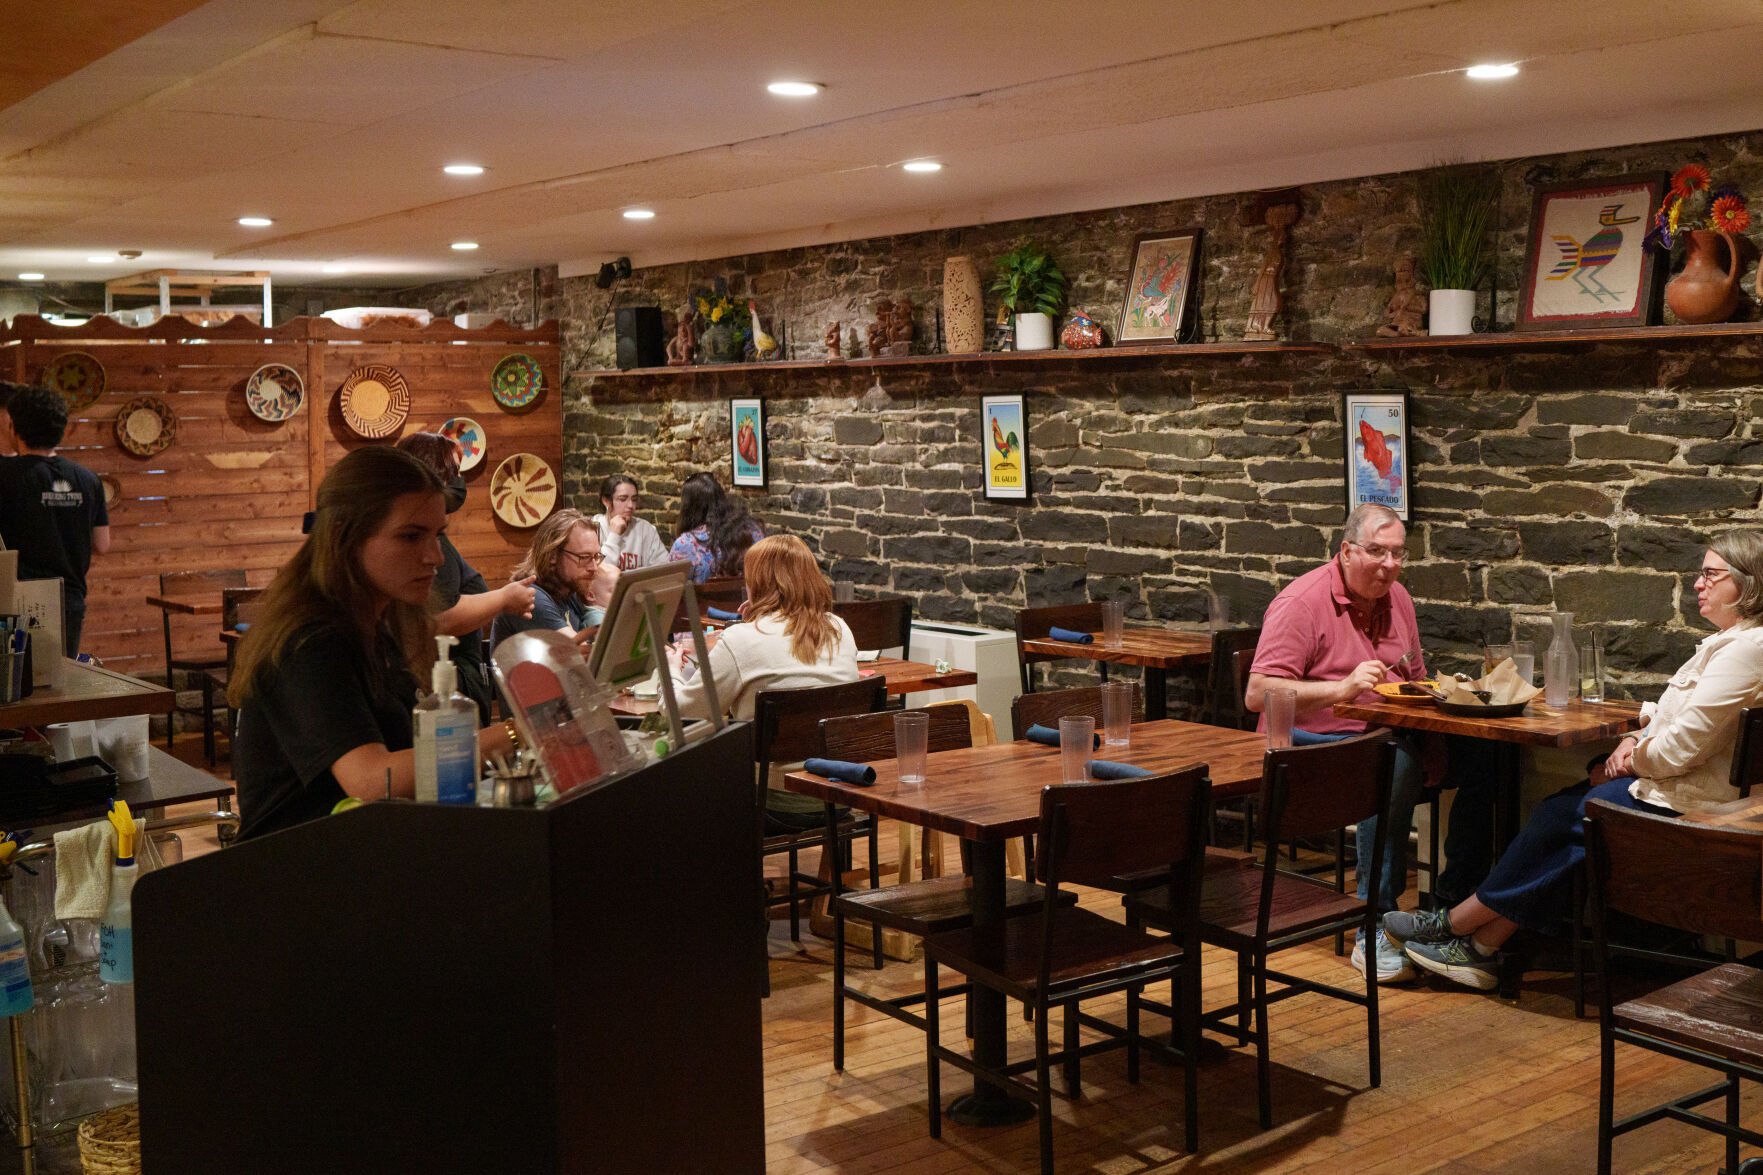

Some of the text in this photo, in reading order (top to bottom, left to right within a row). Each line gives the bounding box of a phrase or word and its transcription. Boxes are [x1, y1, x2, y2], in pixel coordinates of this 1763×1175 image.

[1388, 409, 1399, 418] 50
[994, 475, 1017, 483] EL GALLO
[1360, 494, 1399, 504] EL PESCADO
